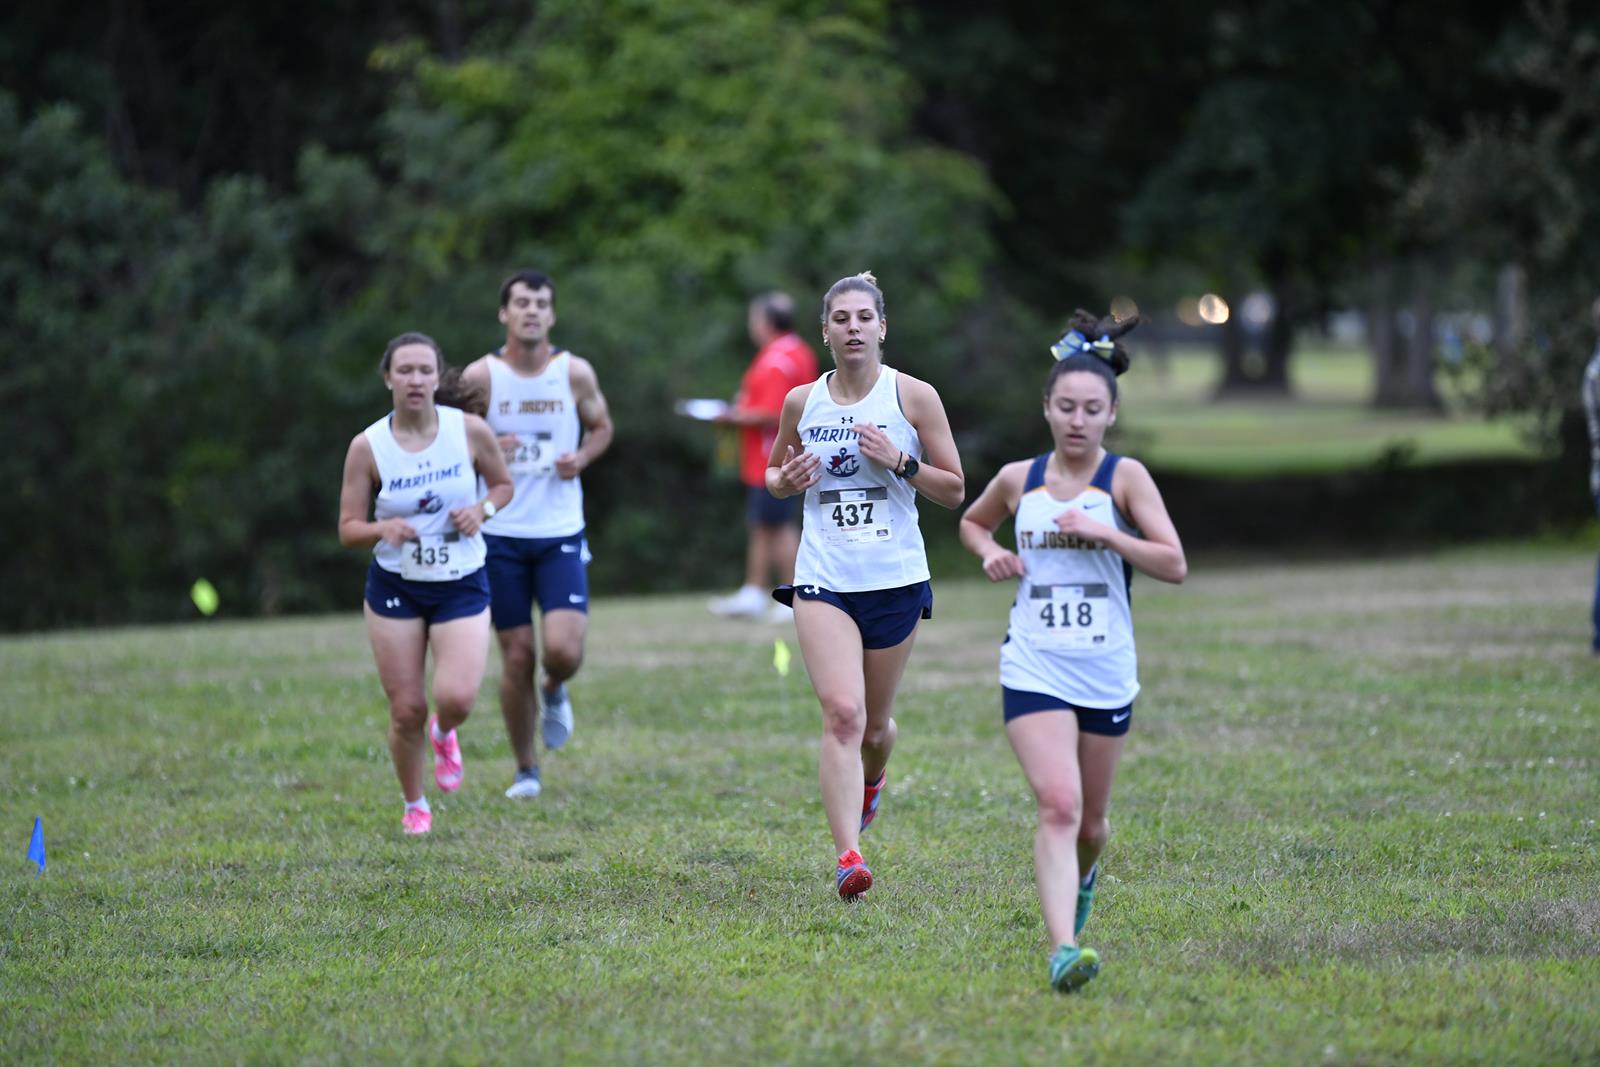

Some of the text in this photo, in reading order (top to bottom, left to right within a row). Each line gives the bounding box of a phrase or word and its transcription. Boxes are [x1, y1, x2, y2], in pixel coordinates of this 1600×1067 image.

[832, 502, 873, 527] 437
[411, 546, 449, 565] 435
[1040, 602, 1092, 628] 418
